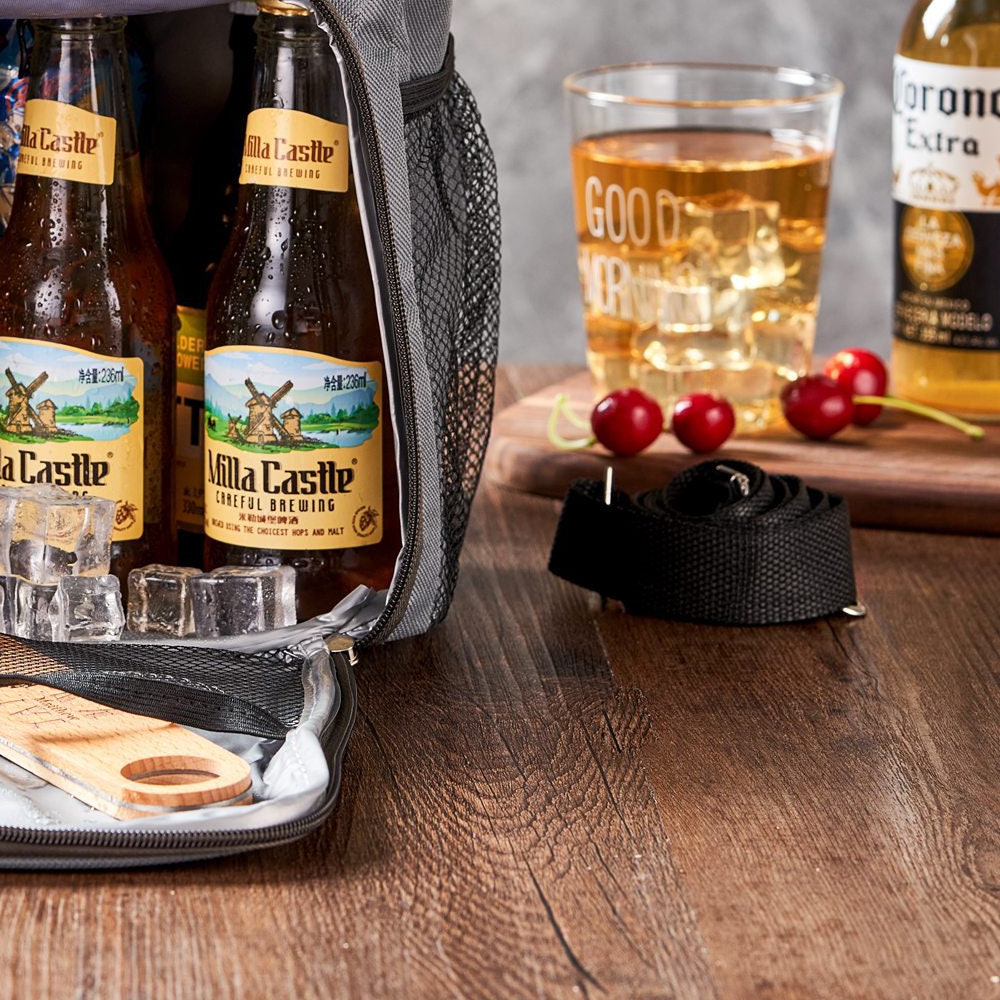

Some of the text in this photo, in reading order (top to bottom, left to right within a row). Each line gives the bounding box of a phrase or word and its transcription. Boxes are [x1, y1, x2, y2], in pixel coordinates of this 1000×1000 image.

[40, 127, 98, 155] Castle
[906, 118, 979, 155] Extra
[274, 137, 334, 163] Castle
[42, 157, 83, 170] BREWING
[277, 167, 320, 180] BREWING
[585, 175, 680, 247] GOOD
[177, 335, 204, 354] DER
[19, 449, 111, 487] Castle
[208, 449, 354, 495] Milla Castle
[216, 490, 263, 511] CAREFUL
[270, 498, 335, 512] BREWING
[244, 525, 254, 534] THE
[257, 527, 288, 536] CHOICEST
[292, 528, 308, 537] HOPS
[312, 528, 325, 537] AND
[328, 526, 345, 536] MALT
